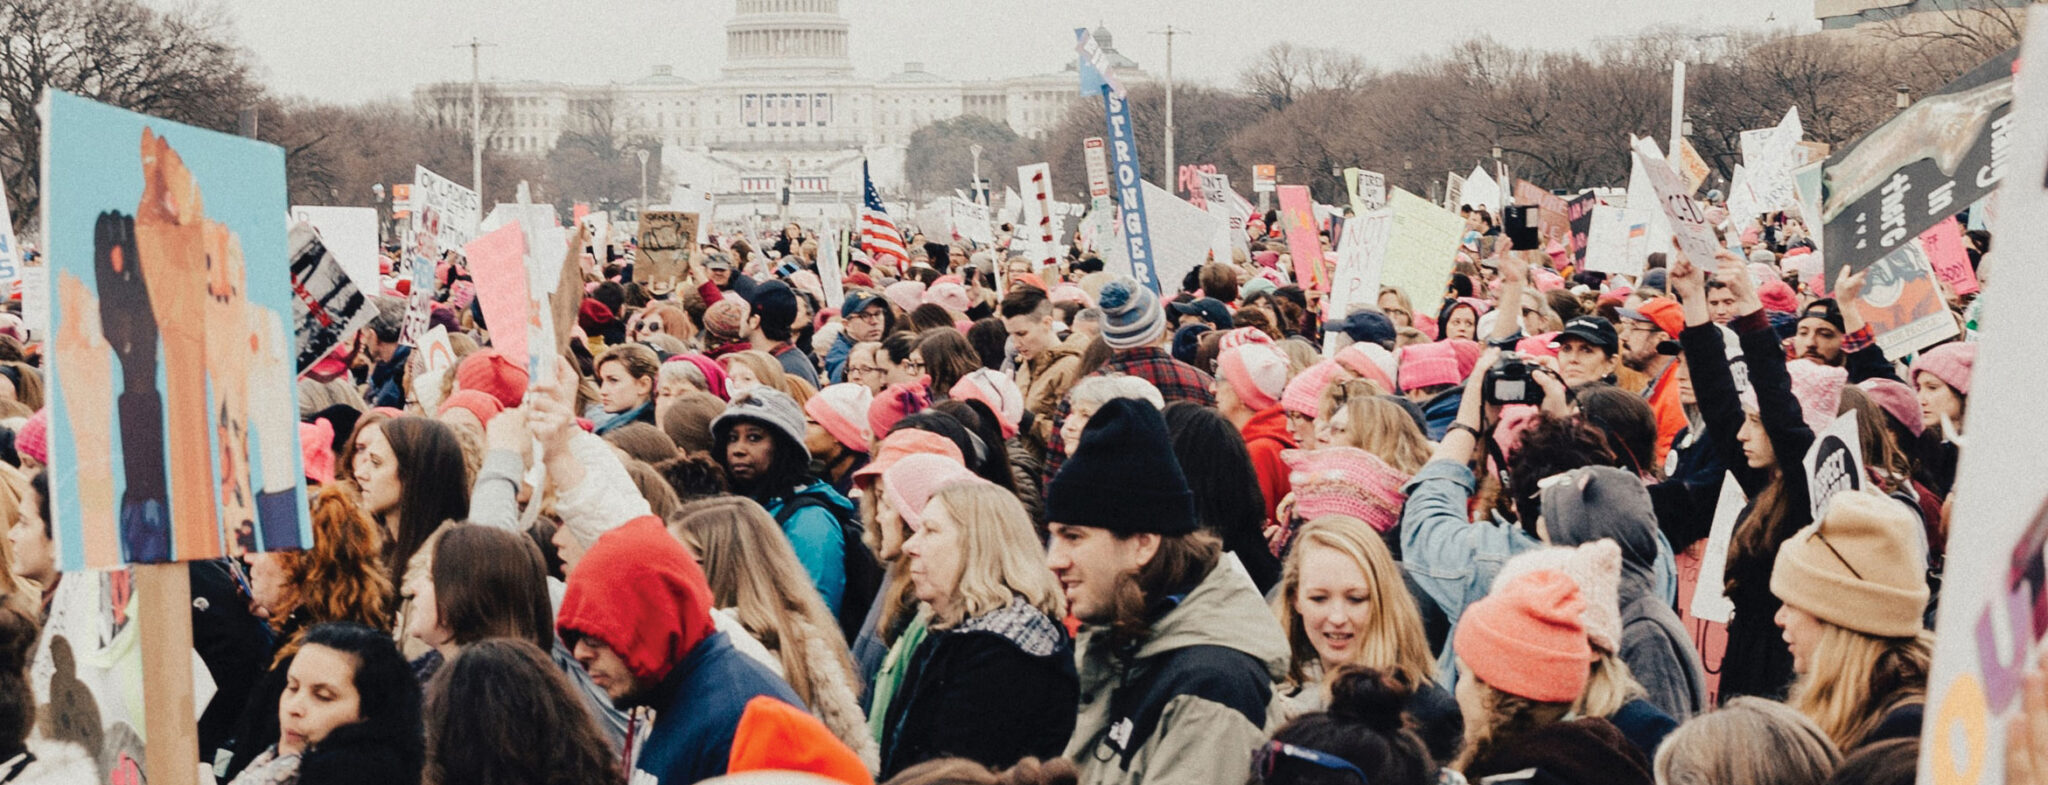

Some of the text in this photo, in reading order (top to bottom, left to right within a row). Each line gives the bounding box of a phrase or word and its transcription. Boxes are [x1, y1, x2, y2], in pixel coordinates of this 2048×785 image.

[1108, 91, 1151, 285] STRONGER
[1347, 214, 1389, 248] NOT
[1347, 246, 1373, 272] MY
